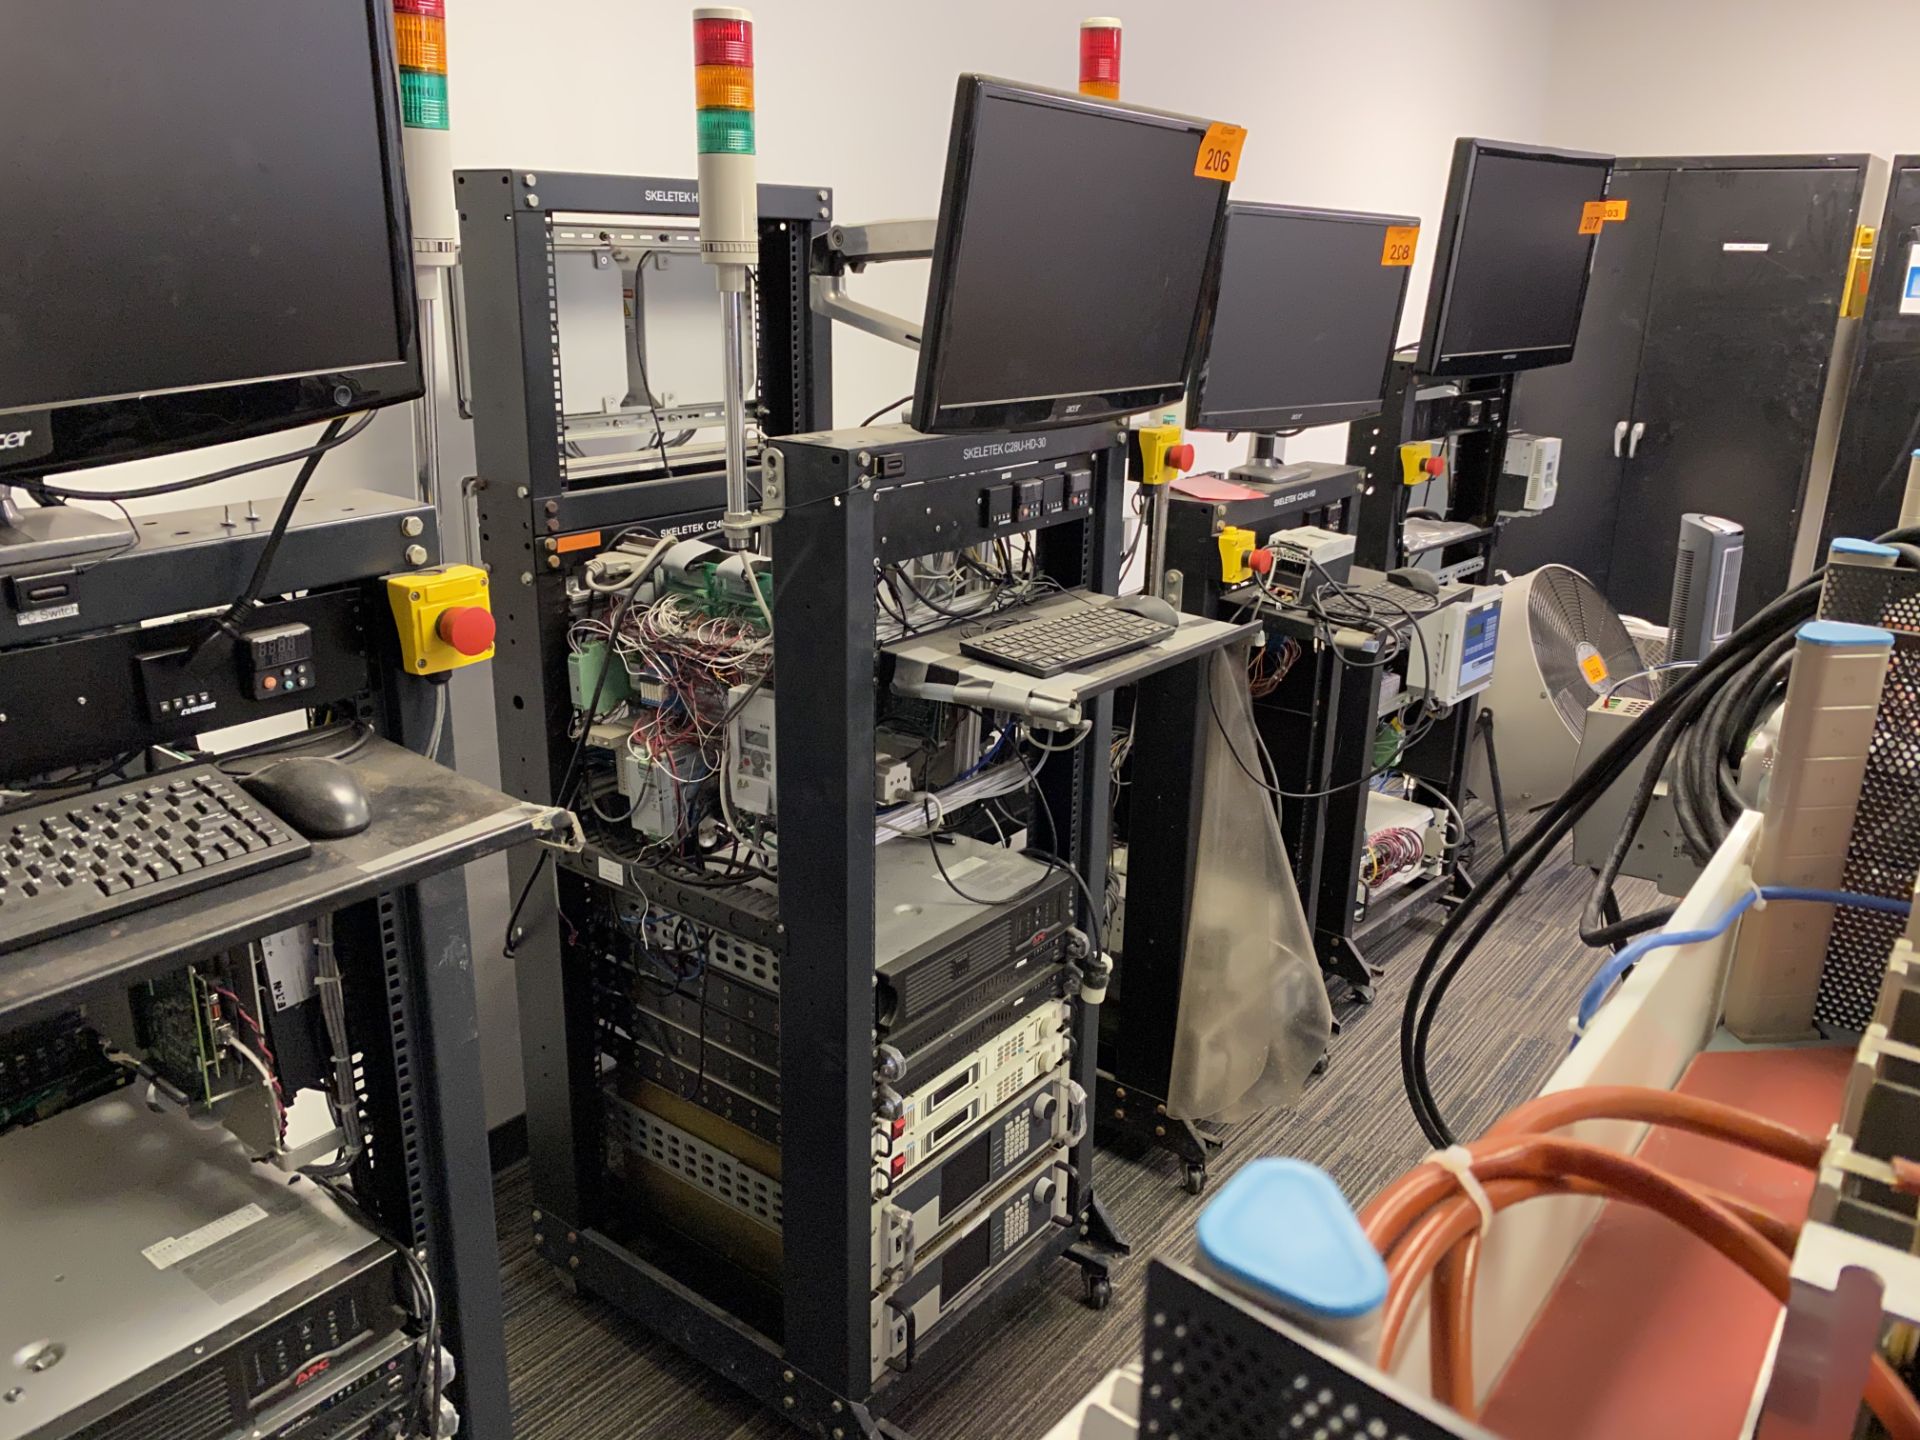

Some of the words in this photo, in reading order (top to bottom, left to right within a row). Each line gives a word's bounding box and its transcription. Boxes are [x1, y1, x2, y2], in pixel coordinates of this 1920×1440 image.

[1204, 148, 1231, 173] 206
[644, 189, 691, 203] SKELETEK
[963, 443, 1004, 460] SKELETEK
[1004, 437, 1047, 454] C28U-HD-30
[660, 523, 704, 538] SKELETEK
[40, 604, 79, 620] Switch
[295, 1357, 331, 1386] APC
